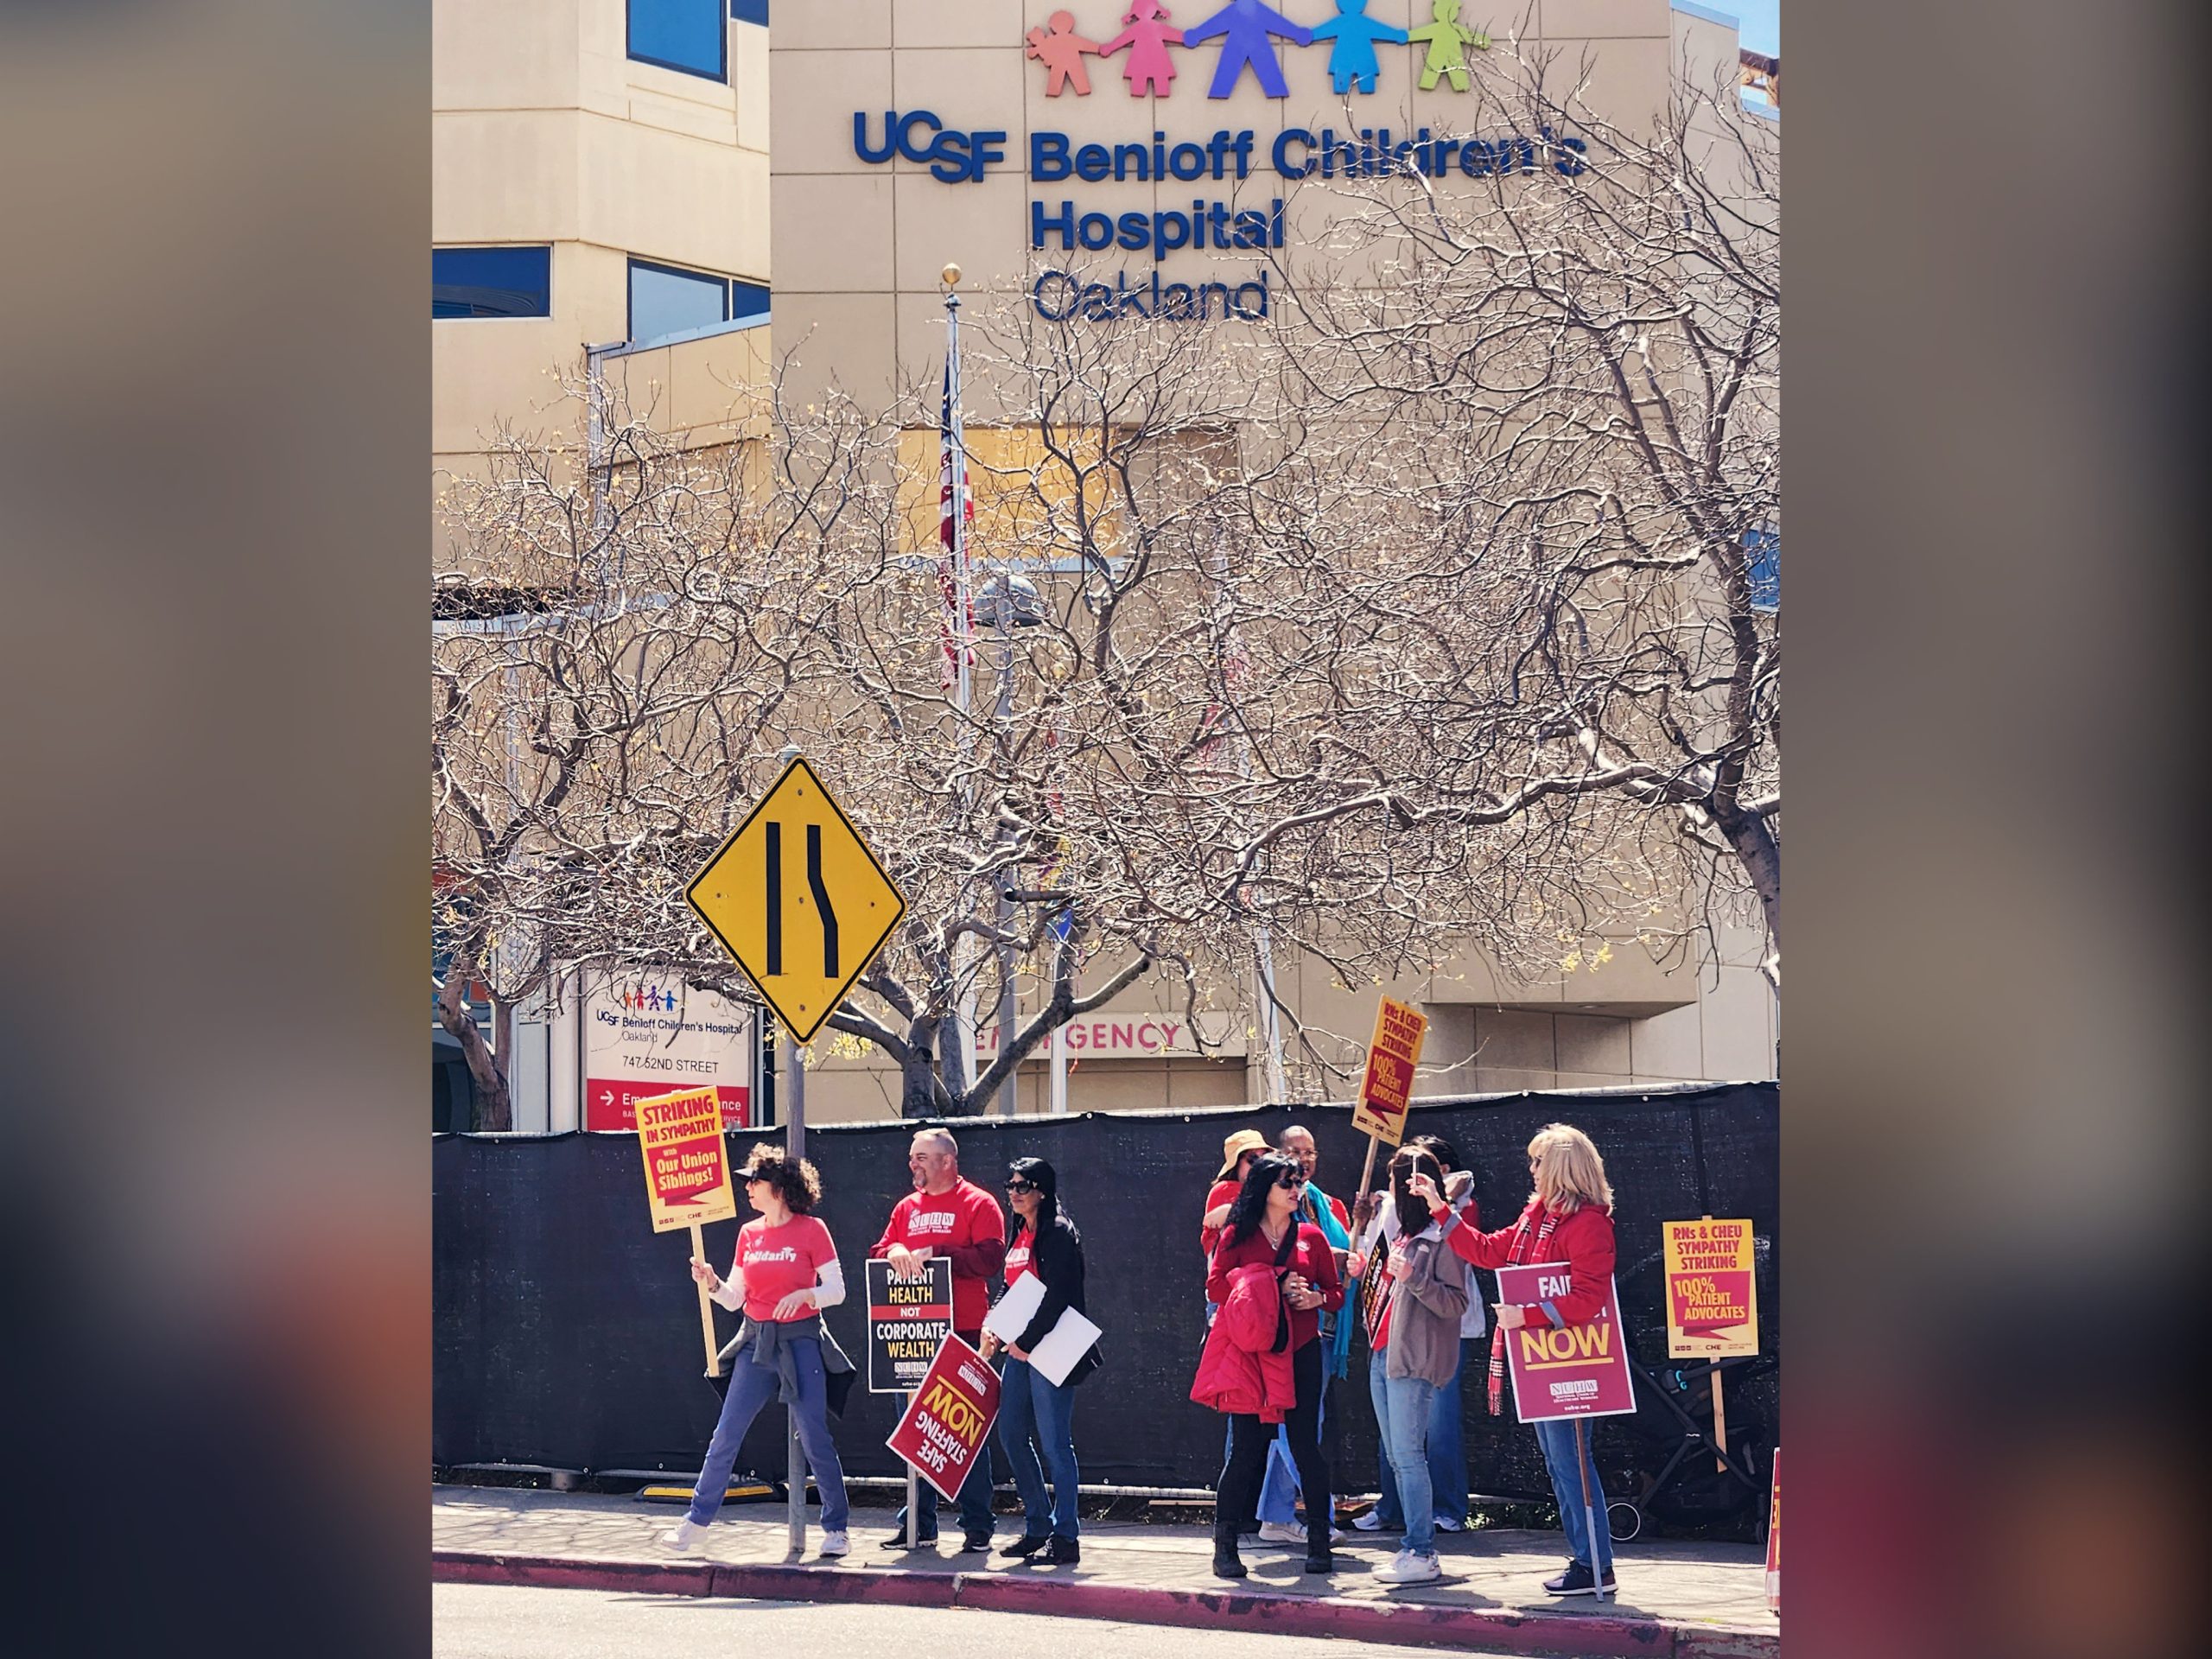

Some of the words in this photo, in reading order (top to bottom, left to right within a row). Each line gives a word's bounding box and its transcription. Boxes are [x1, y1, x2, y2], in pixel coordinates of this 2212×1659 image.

[854, 111, 1006, 184] UCSF
[1030, 130, 1253, 182] Benioff
[1271, 128, 1587, 181] Children's
[1031, 199, 1284, 261] Hospital
[1034, 270, 1268, 322] Oakland
[596, 1009, 620, 1027] UCSF
[705, 1023, 742, 1035] Hospital
[1383, 1018, 1418, 1045] SYMPATHY
[622, 1030, 658, 1043] Oakland
[623, 1055, 642, 1068] 747
[645, 1057, 672, 1071] 52ND
[677, 1059, 719, 1073] STREET
[1373, 1053, 1396, 1077] 100%
[1370, 1083, 1405, 1108] ADVOCATES
[643, 1095, 714, 1126] STRIKING
[646, 1129, 659, 1143] IN
[661, 1117, 716, 1141] SYMPATHY
[657, 1158, 678, 1174] Our
[681, 1151, 718, 1166] Union
[658, 1166, 713, 1192] Siblings!
[1673, 1227, 1696, 1240] RNs
[1700, 1226, 1707, 1239] &
[1712, 1225, 1743, 1239] CHEU
[1677, 1240, 1739, 1255] SYMPATHY
[1681, 1255, 1737, 1270] STRIKING
[889, 1286, 933, 1304] HEALTH
[1675, 1276, 1715, 1298] 100%
[1689, 1292, 1731, 1306] PATIENT
[900, 1306, 921, 1317] NOT
[1685, 1306, 1745, 1320] ADVOCATES
[877, 1322, 946, 1340] CORPORATE
[1520, 1322, 1610, 1363] NOW
[888, 1341, 935, 1358] WEALTH
[895, 1362, 927, 1372] NUHW
[1550, 1380, 1598, 1395] NUHW
[922, 1383, 983, 1447] NOW
[915, 1410, 968, 1465] STAFFING
[917, 1439, 948, 1473] SAFE
